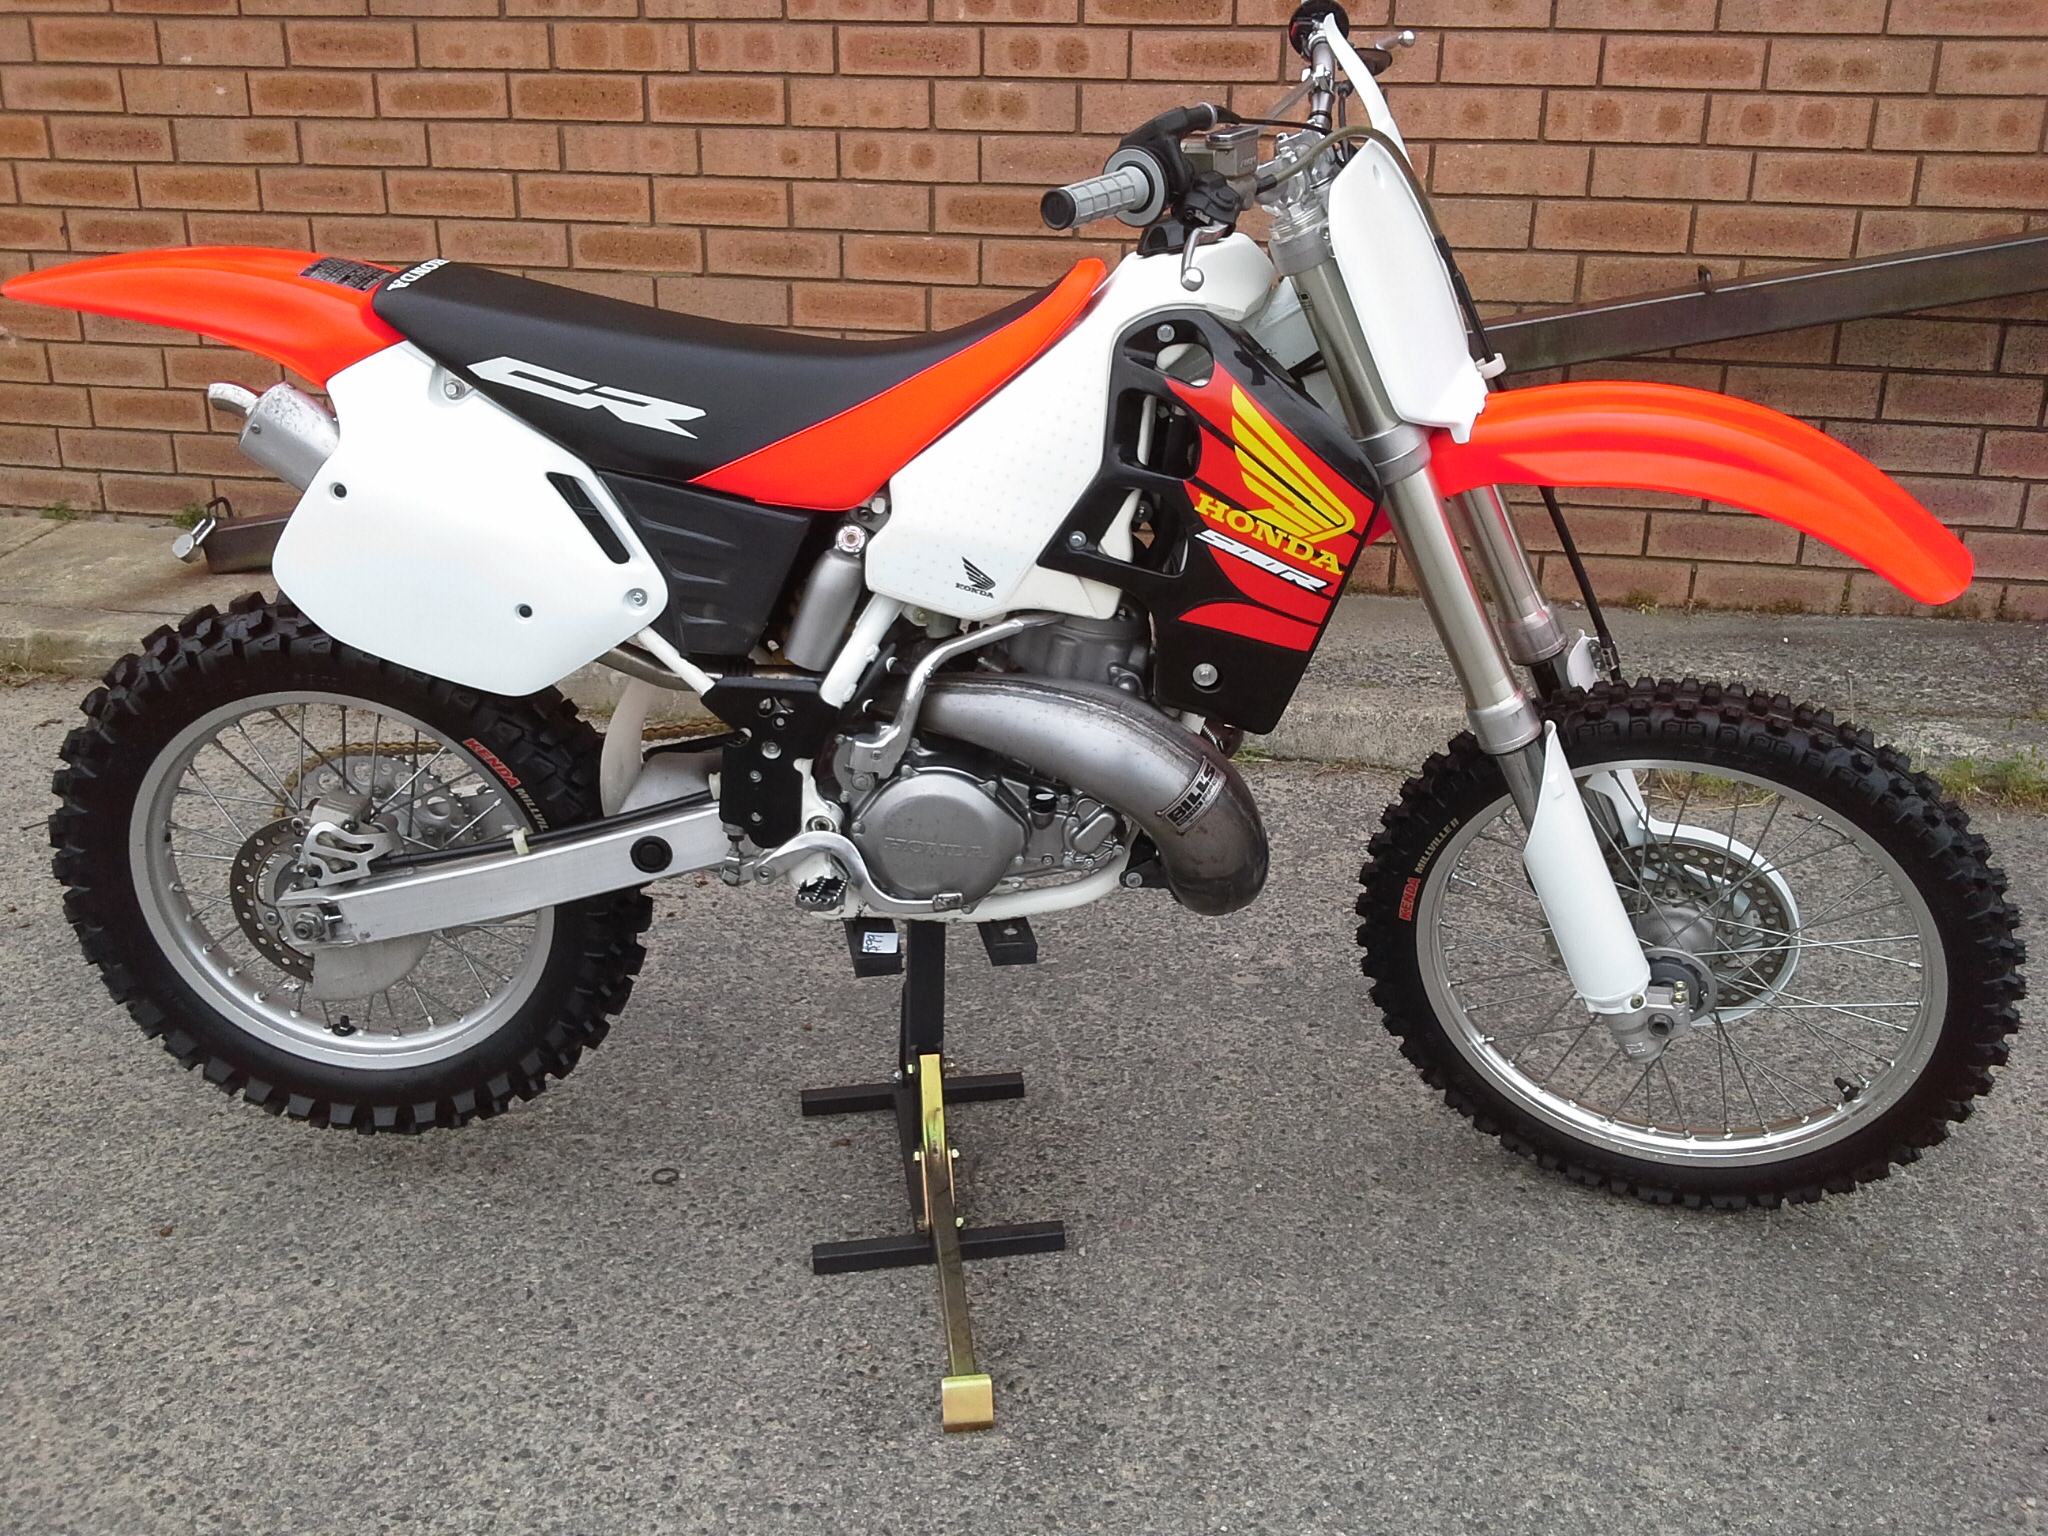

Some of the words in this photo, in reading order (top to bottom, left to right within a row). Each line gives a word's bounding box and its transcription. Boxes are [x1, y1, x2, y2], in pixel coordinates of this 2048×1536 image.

[387, 258, 450, 291] HONDA
[466, 355, 707, 440] CR
[1194, 492, 1345, 576] HONDA
[955, 582, 994, 599] HONDA
[462, 737, 521, 789] KENDA
[1166, 762, 1216, 823] BILL'S
[883, 836, 990, 860] HONDA
[1398, 876, 1422, 922] KENDA
[1414, 824, 1453, 875] MILLVILLE
